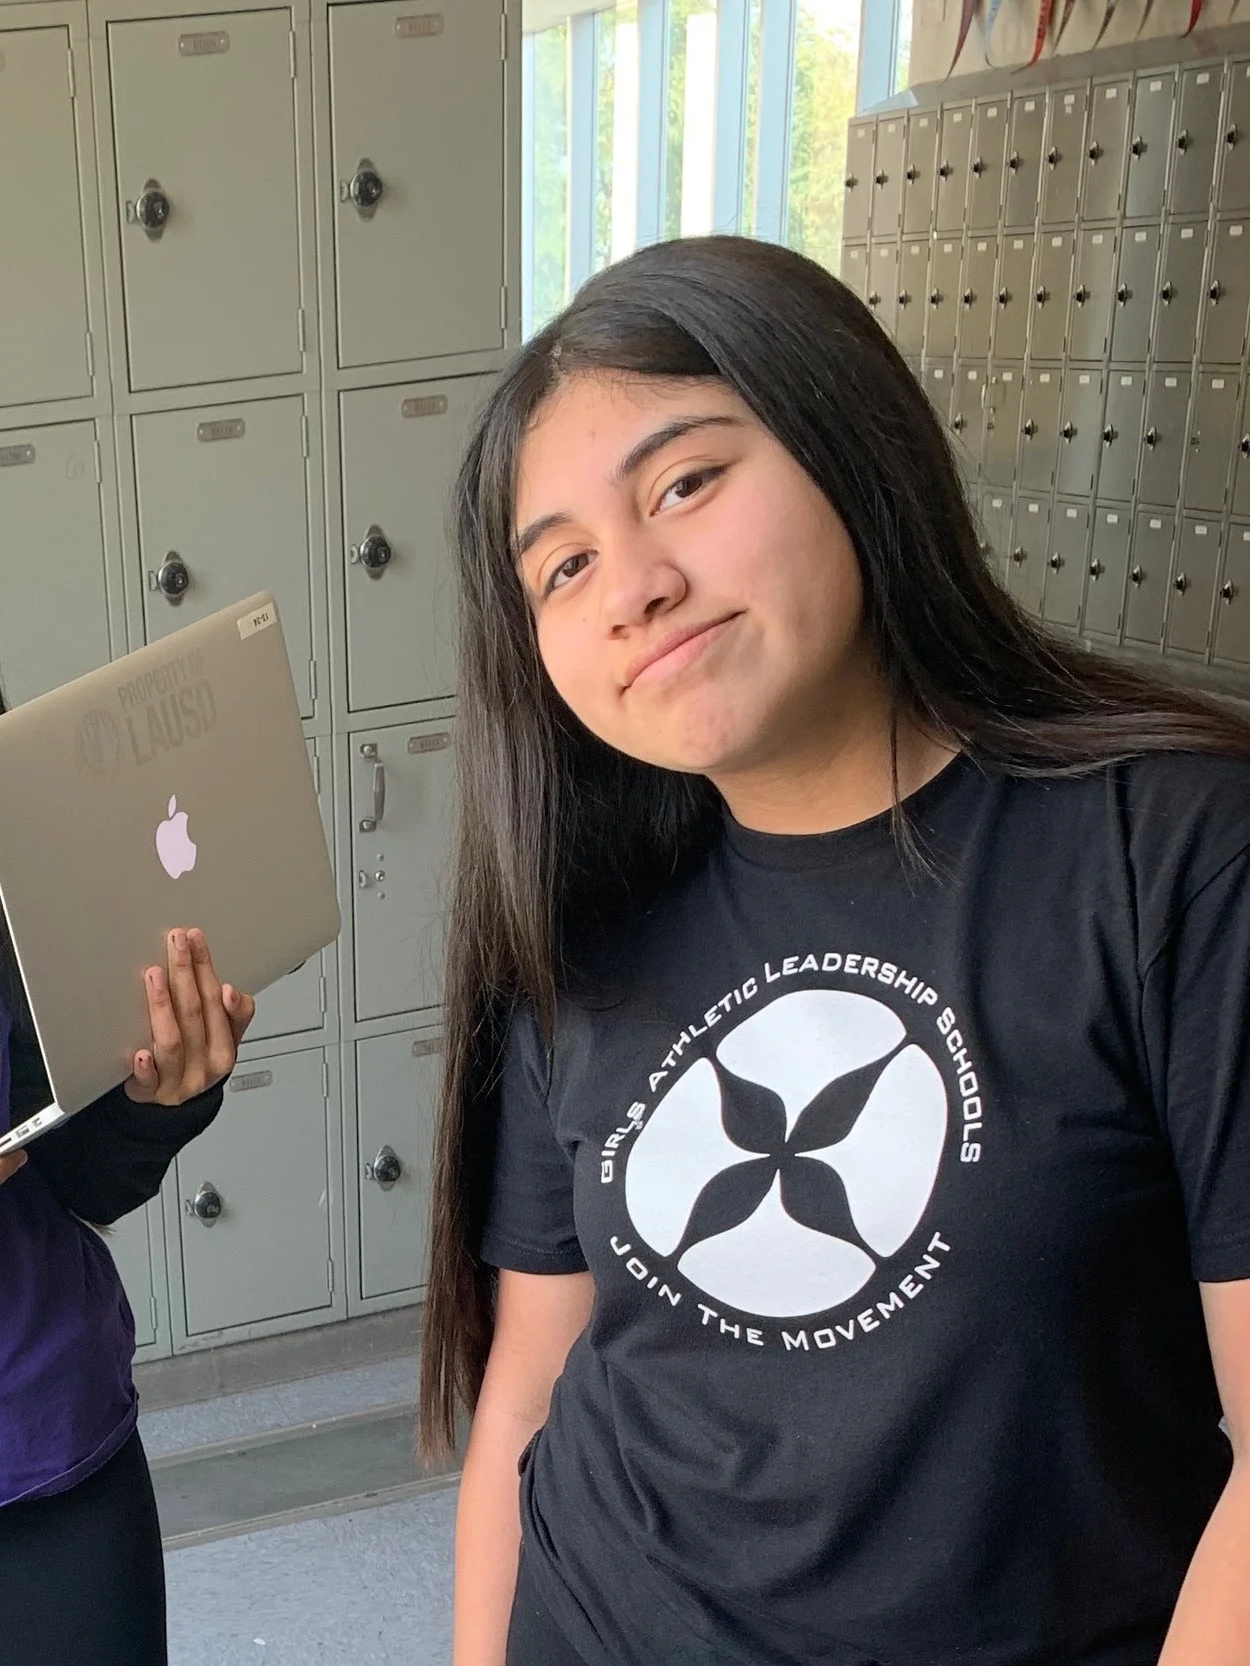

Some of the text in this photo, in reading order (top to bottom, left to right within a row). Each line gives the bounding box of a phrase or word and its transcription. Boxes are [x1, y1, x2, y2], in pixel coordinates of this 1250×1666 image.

[117, 657, 187, 712] PROPERTY
[125, 680, 217, 767] LAUSD
[600, 952, 983, 1184] GIRLS ATHLETIC LEADERSHIP SCHOOLS
[609, 1231, 952, 1352] JOIN THE MOVEMENT
